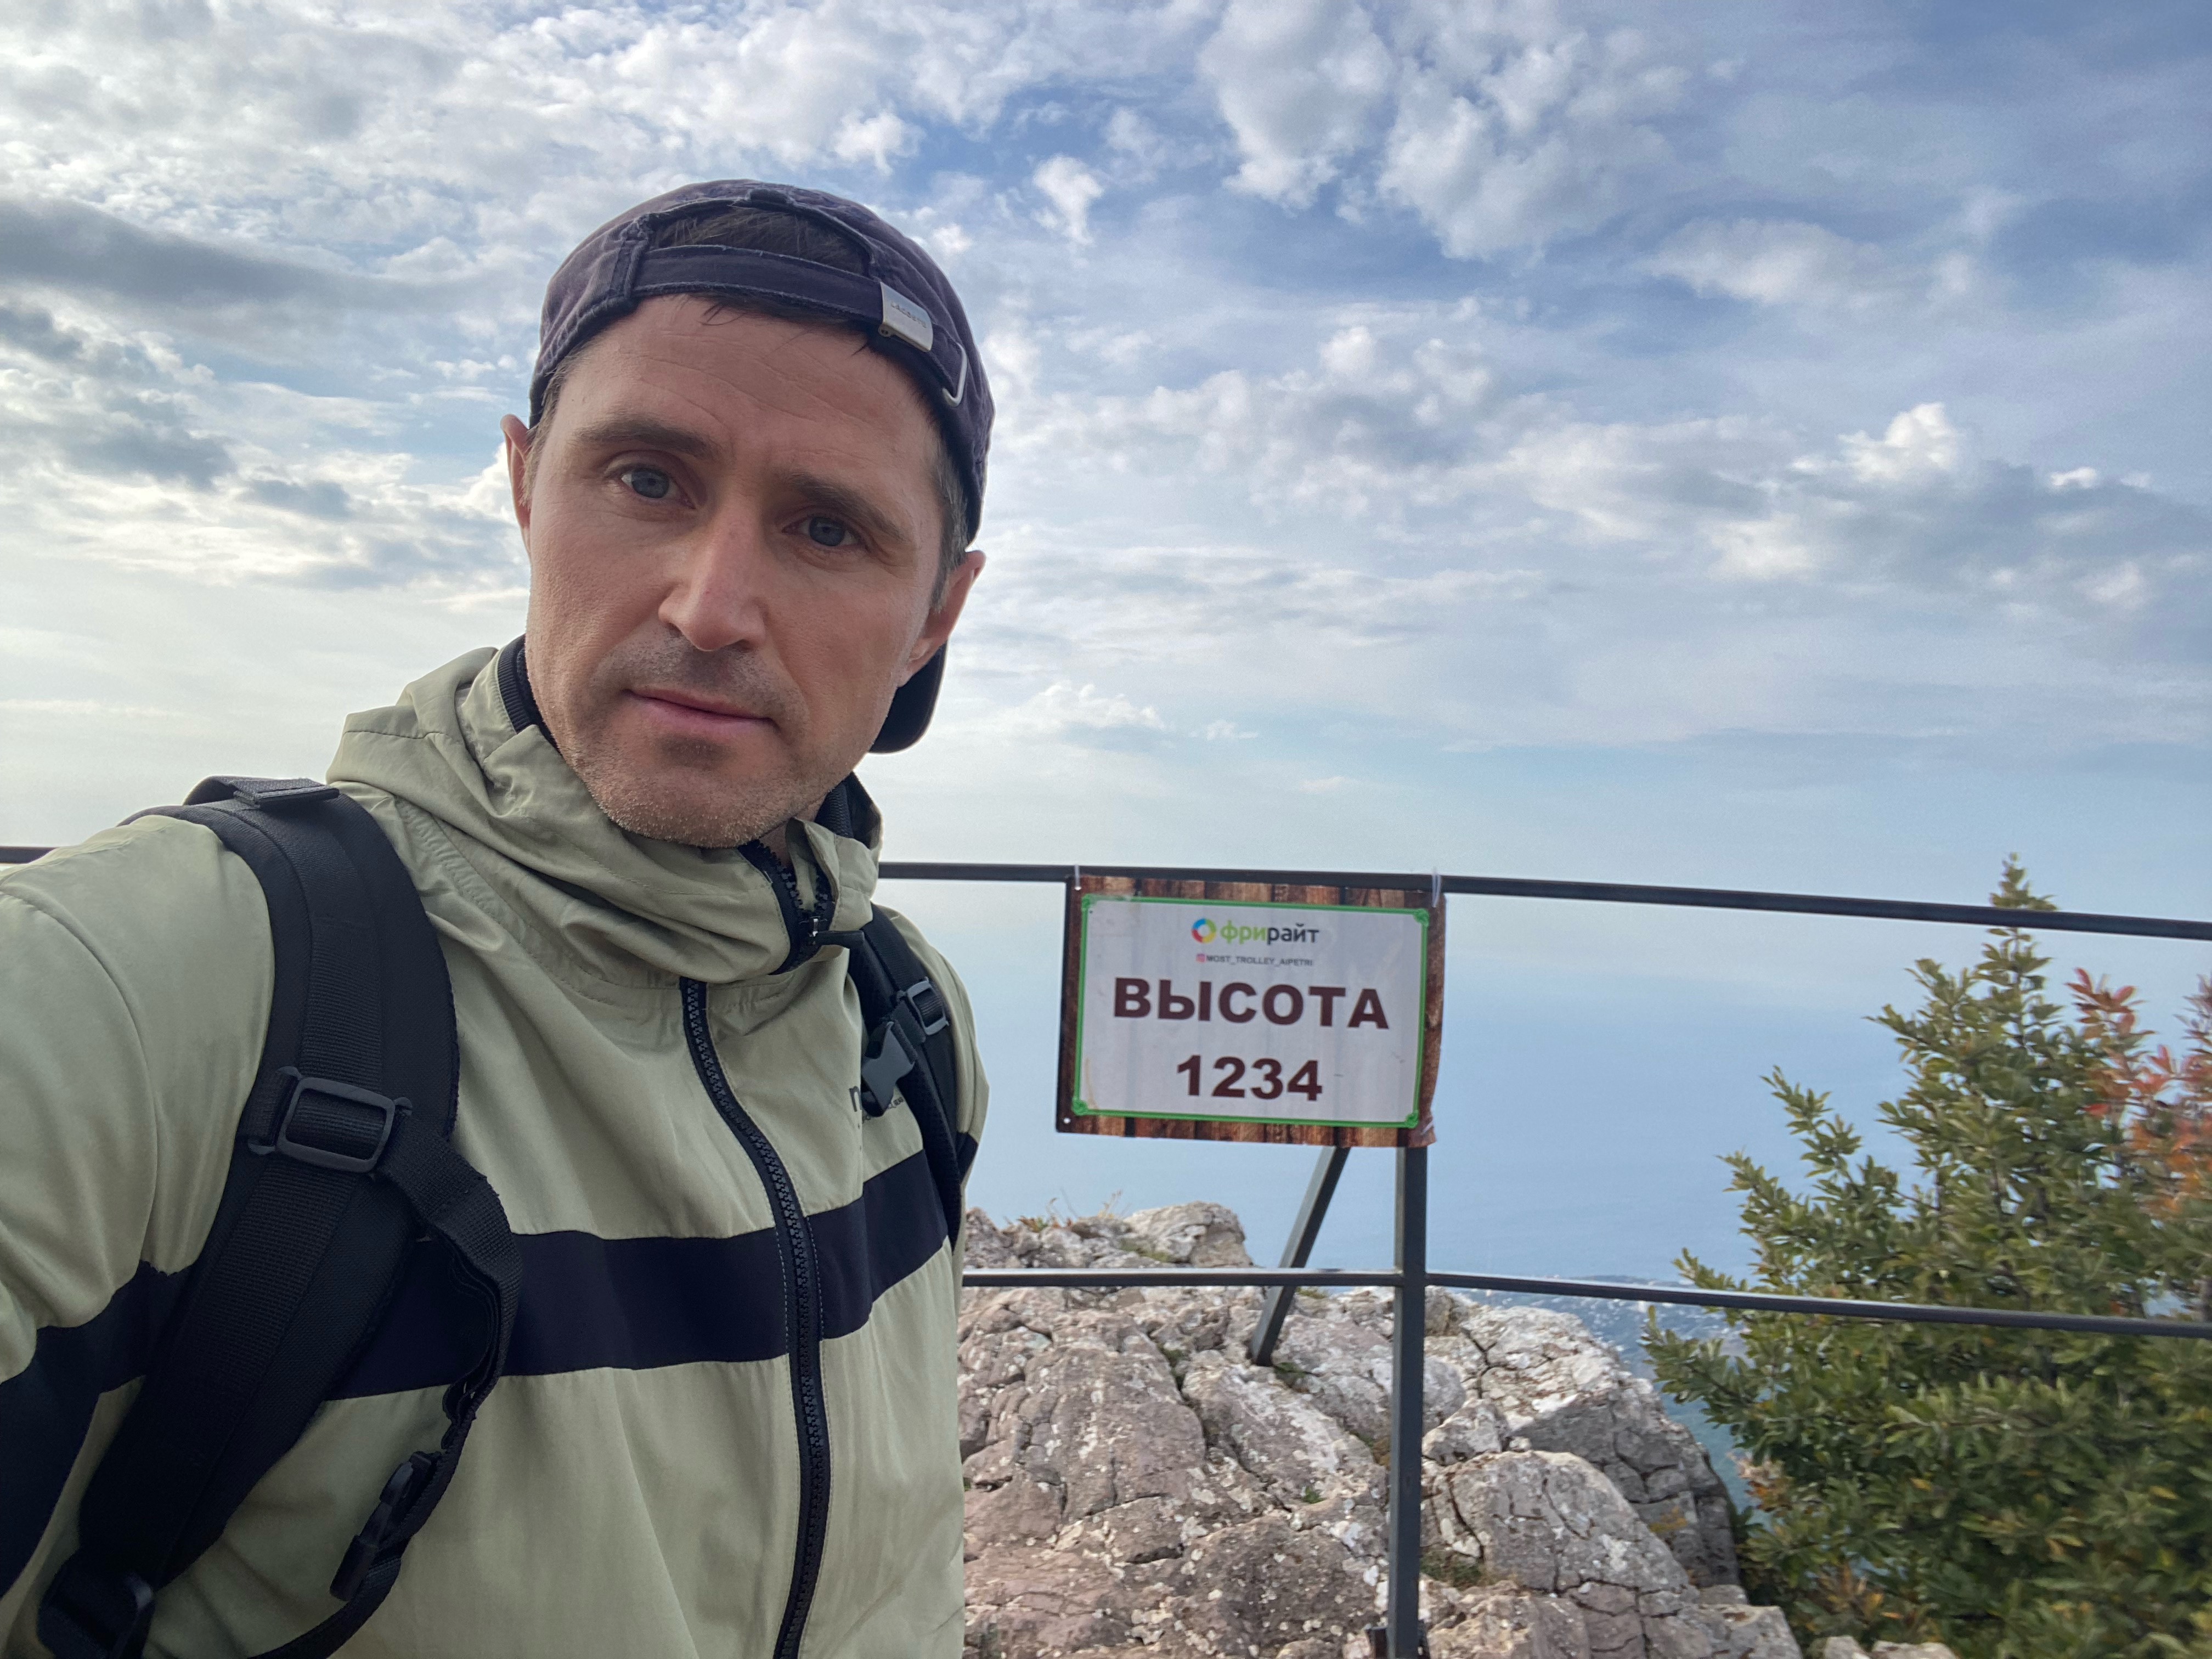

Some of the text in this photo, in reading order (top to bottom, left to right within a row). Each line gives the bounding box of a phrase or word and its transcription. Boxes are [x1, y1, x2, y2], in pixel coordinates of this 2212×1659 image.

[1220, 919, 1319, 946] фрирайт
[1114, 977, 1389, 1030] ВЫСОТА
[1177, 1055, 1323, 1102] 1234
